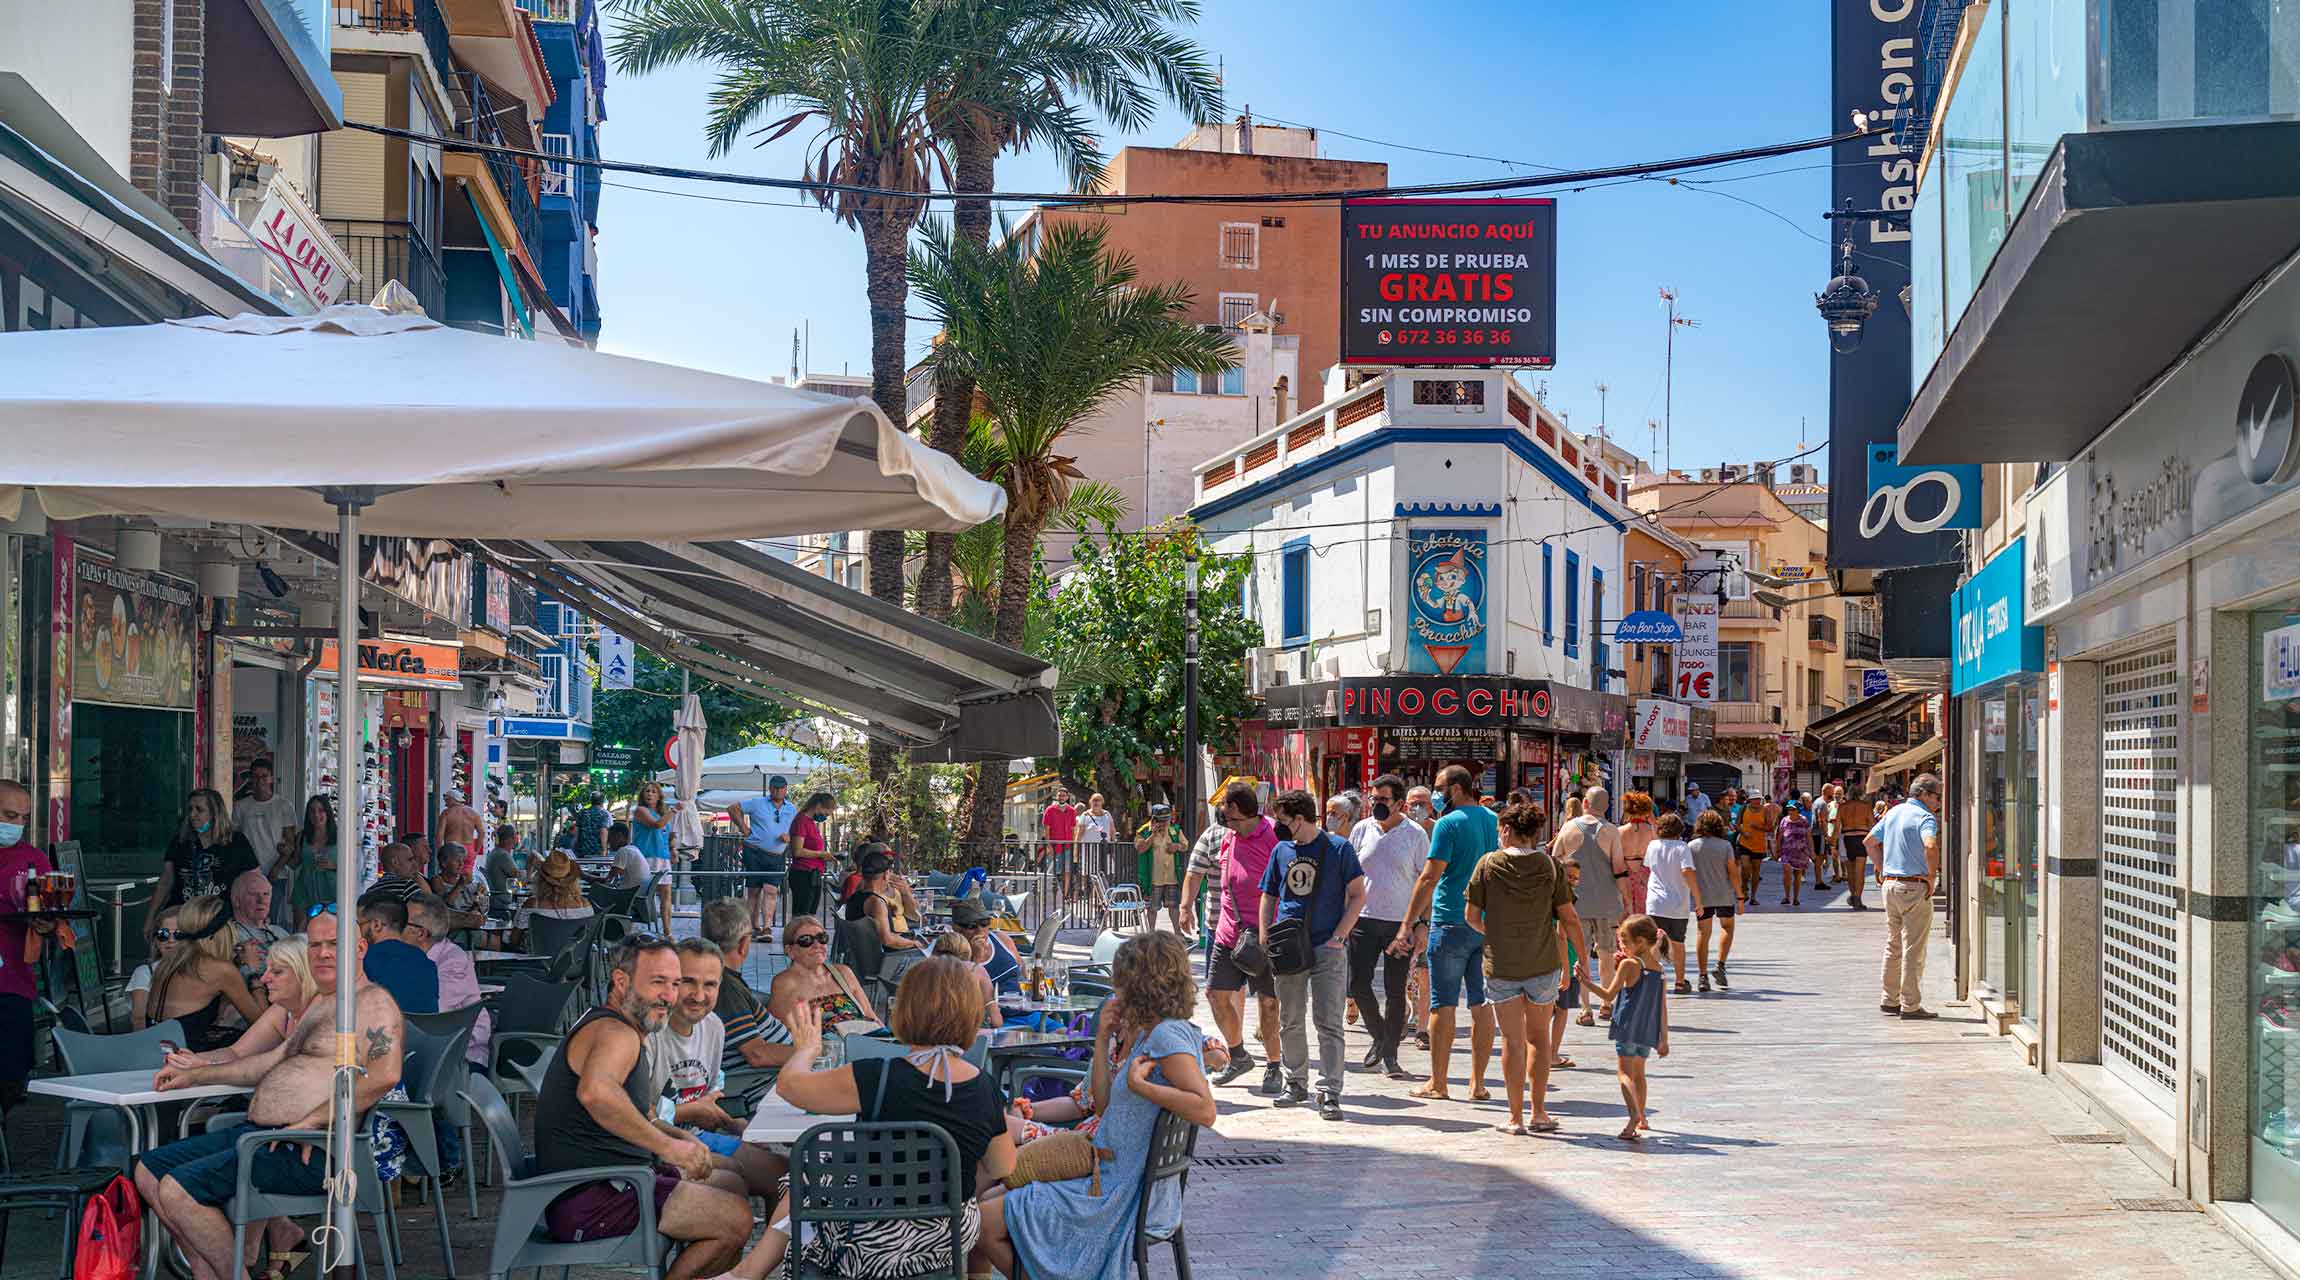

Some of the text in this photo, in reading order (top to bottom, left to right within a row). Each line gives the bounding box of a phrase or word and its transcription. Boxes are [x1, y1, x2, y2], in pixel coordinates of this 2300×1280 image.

[1868, 38, 1914, 243] Fashion
[1358, 219, 1535, 241] TU ANUNCIO AQUÍ
[270, 208, 335, 287] LA CREU
[1365, 254, 1529, 269] 1 MES DE PRUEBA
[1379, 273, 1514, 302] GRATIS
[1360, 308, 1532, 323] SIN COMPROMISO
[1397, 330, 1511, 344] 672 36 36 36
[81, 561, 101, 583] TAPAS
[1620, 621, 1676, 637] Bon Bon Shop
[1684, 621, 1707, 630] BAR
[1674, 648, 1718, 657] LOUNGE
[428, 666, 457, 677] SHOES
[1680, 661, 1705, 669] TODO
[1679, 671, 1714, 698] 1€
[1344, 687, 1551, 718] PINOCCHIO
[1429, 727, 1461, 737] GOFRES
[1637, 726, 1651, 745] LOW
[1647, 704, 1662, 726] COST
